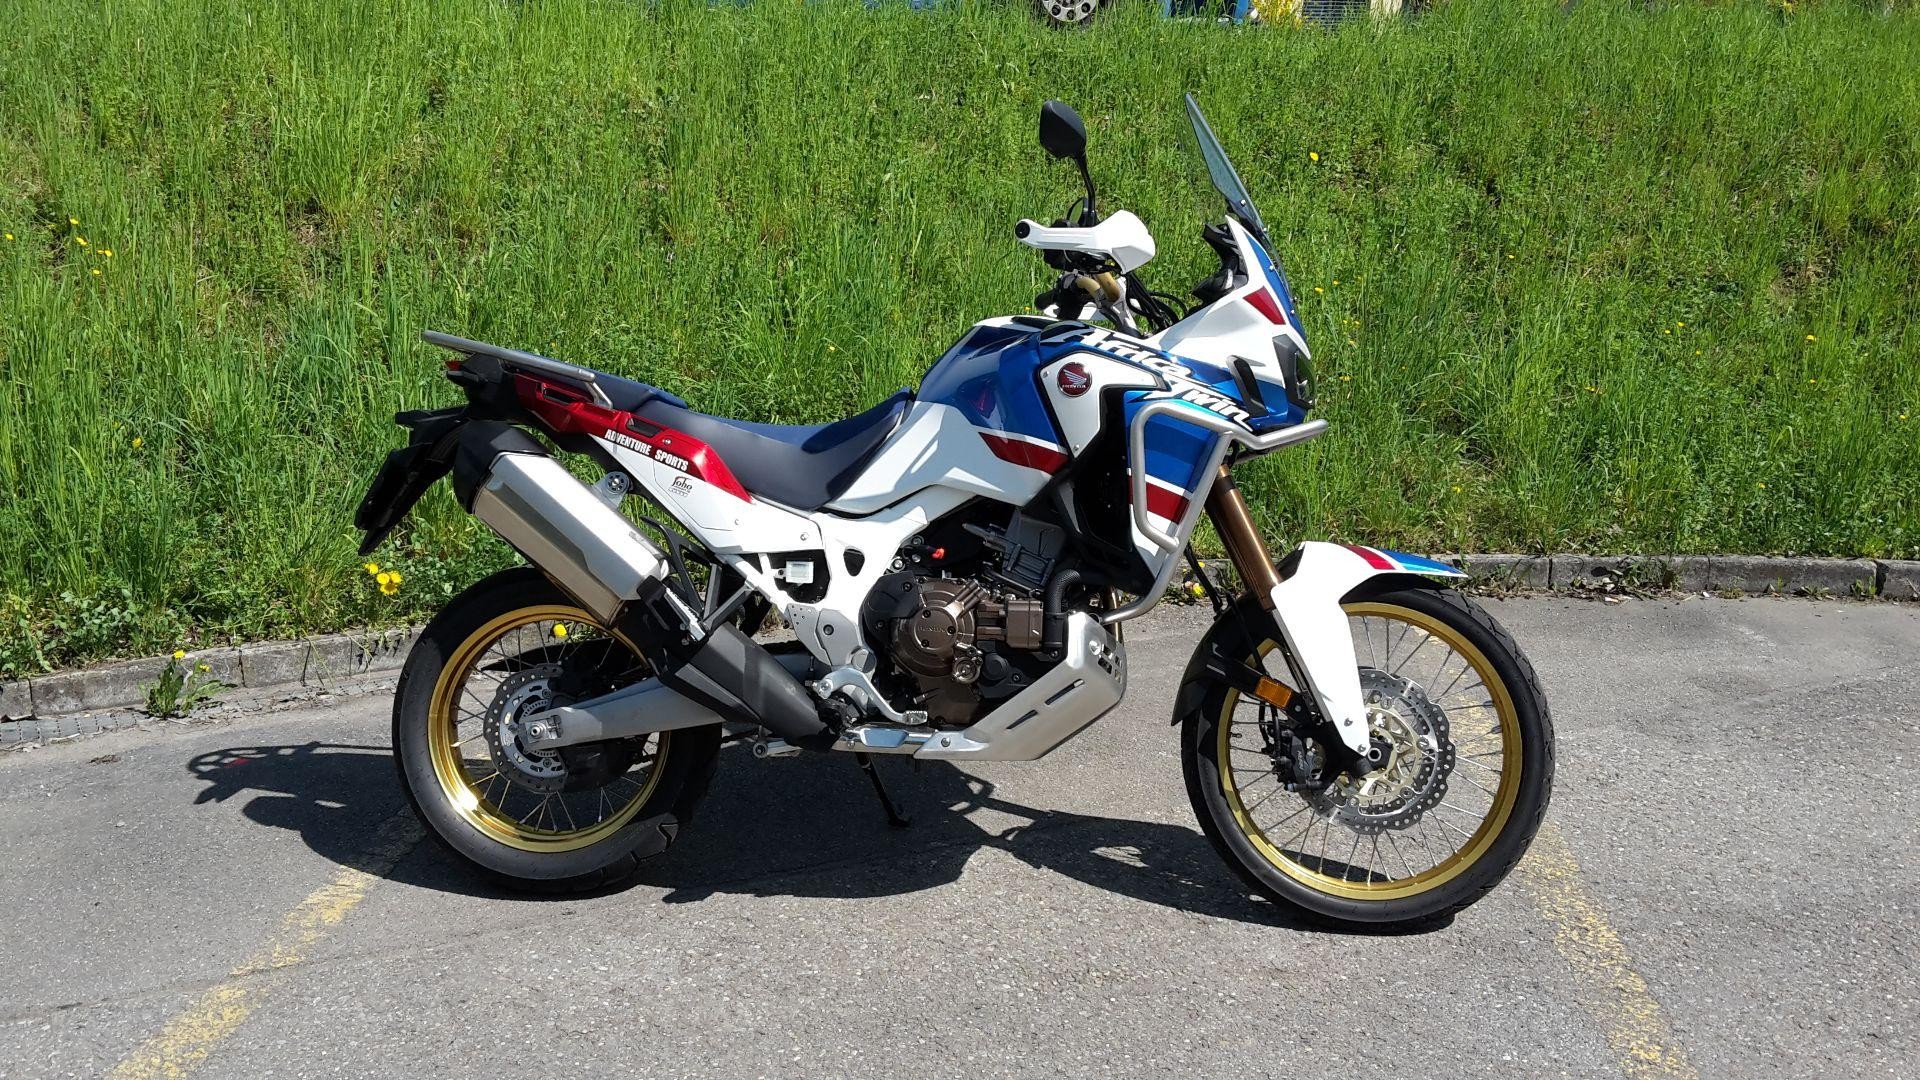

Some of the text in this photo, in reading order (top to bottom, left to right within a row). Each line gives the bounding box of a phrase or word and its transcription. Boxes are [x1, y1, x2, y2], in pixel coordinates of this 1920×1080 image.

[1143, 371, 1254, 433] Twin
[604, 428, 689, 472] ADVENTURE SPORTS
